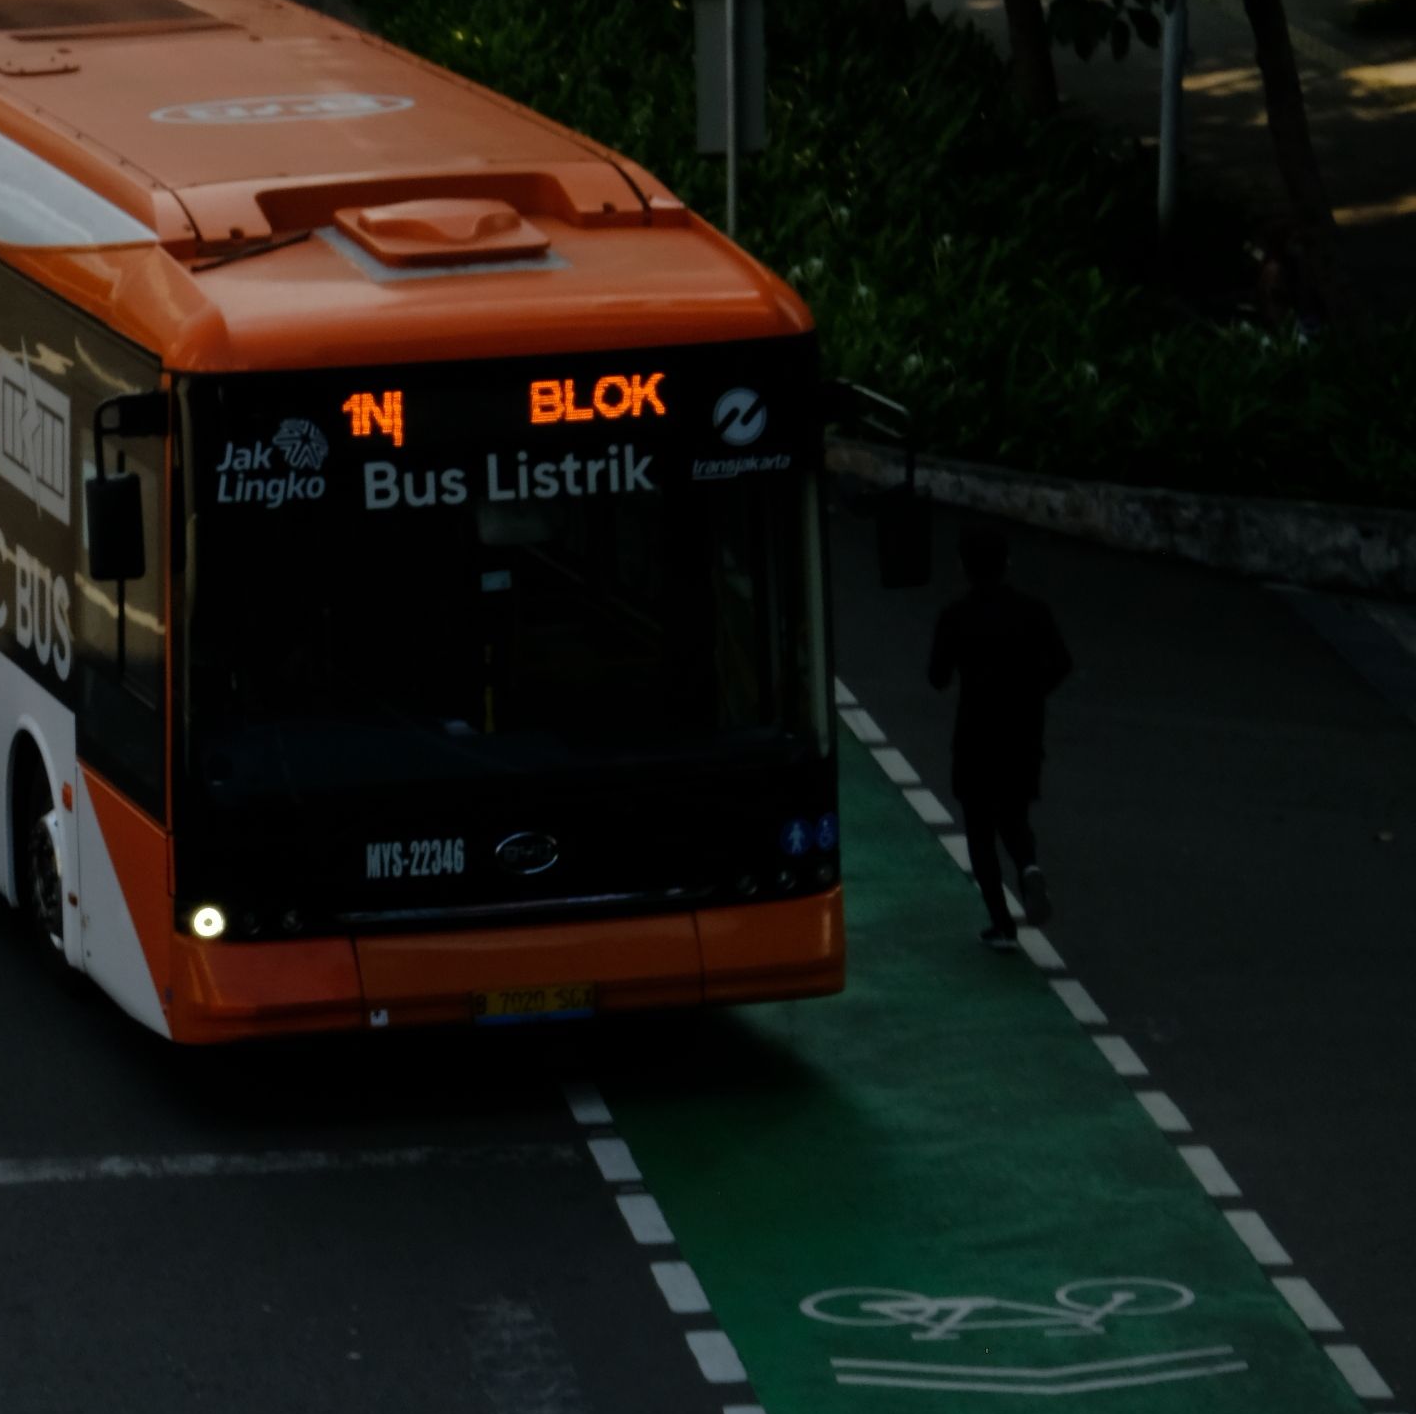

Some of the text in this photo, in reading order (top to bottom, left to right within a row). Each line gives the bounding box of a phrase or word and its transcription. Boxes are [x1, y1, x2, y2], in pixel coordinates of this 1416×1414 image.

[530, 372, 666, 425] BLOK
[215, 440, 274, 472] Jak
[364, 444, 655, 511] Bus Listrik
[217, 470, 327, 510] Lingko
[16, 543, 73, 682] BUS
[365, 836, 465, 879] MYS-22346
